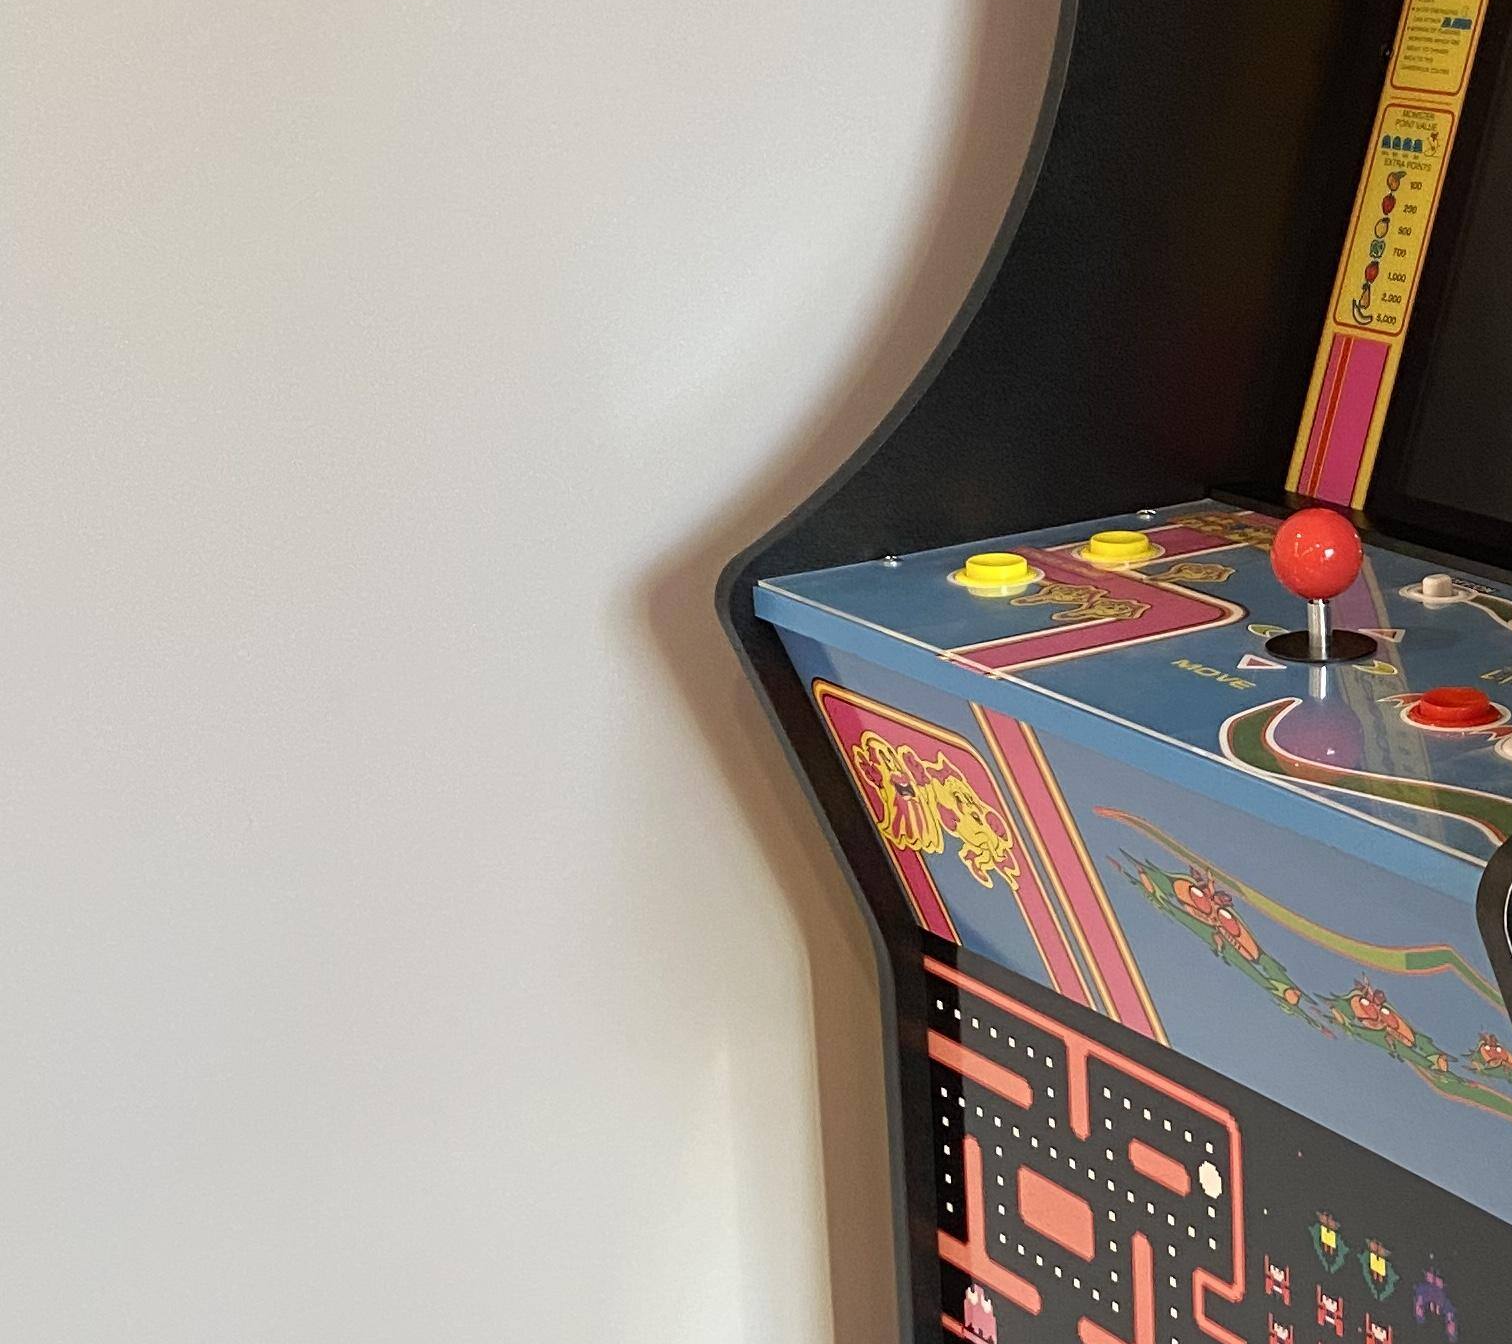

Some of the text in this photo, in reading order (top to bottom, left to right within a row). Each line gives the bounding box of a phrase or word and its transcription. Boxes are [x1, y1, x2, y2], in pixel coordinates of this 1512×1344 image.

[1384, 159, 1432, 172] EXTRA POINTS
[1171, 659, 1256, 690] MOVE
